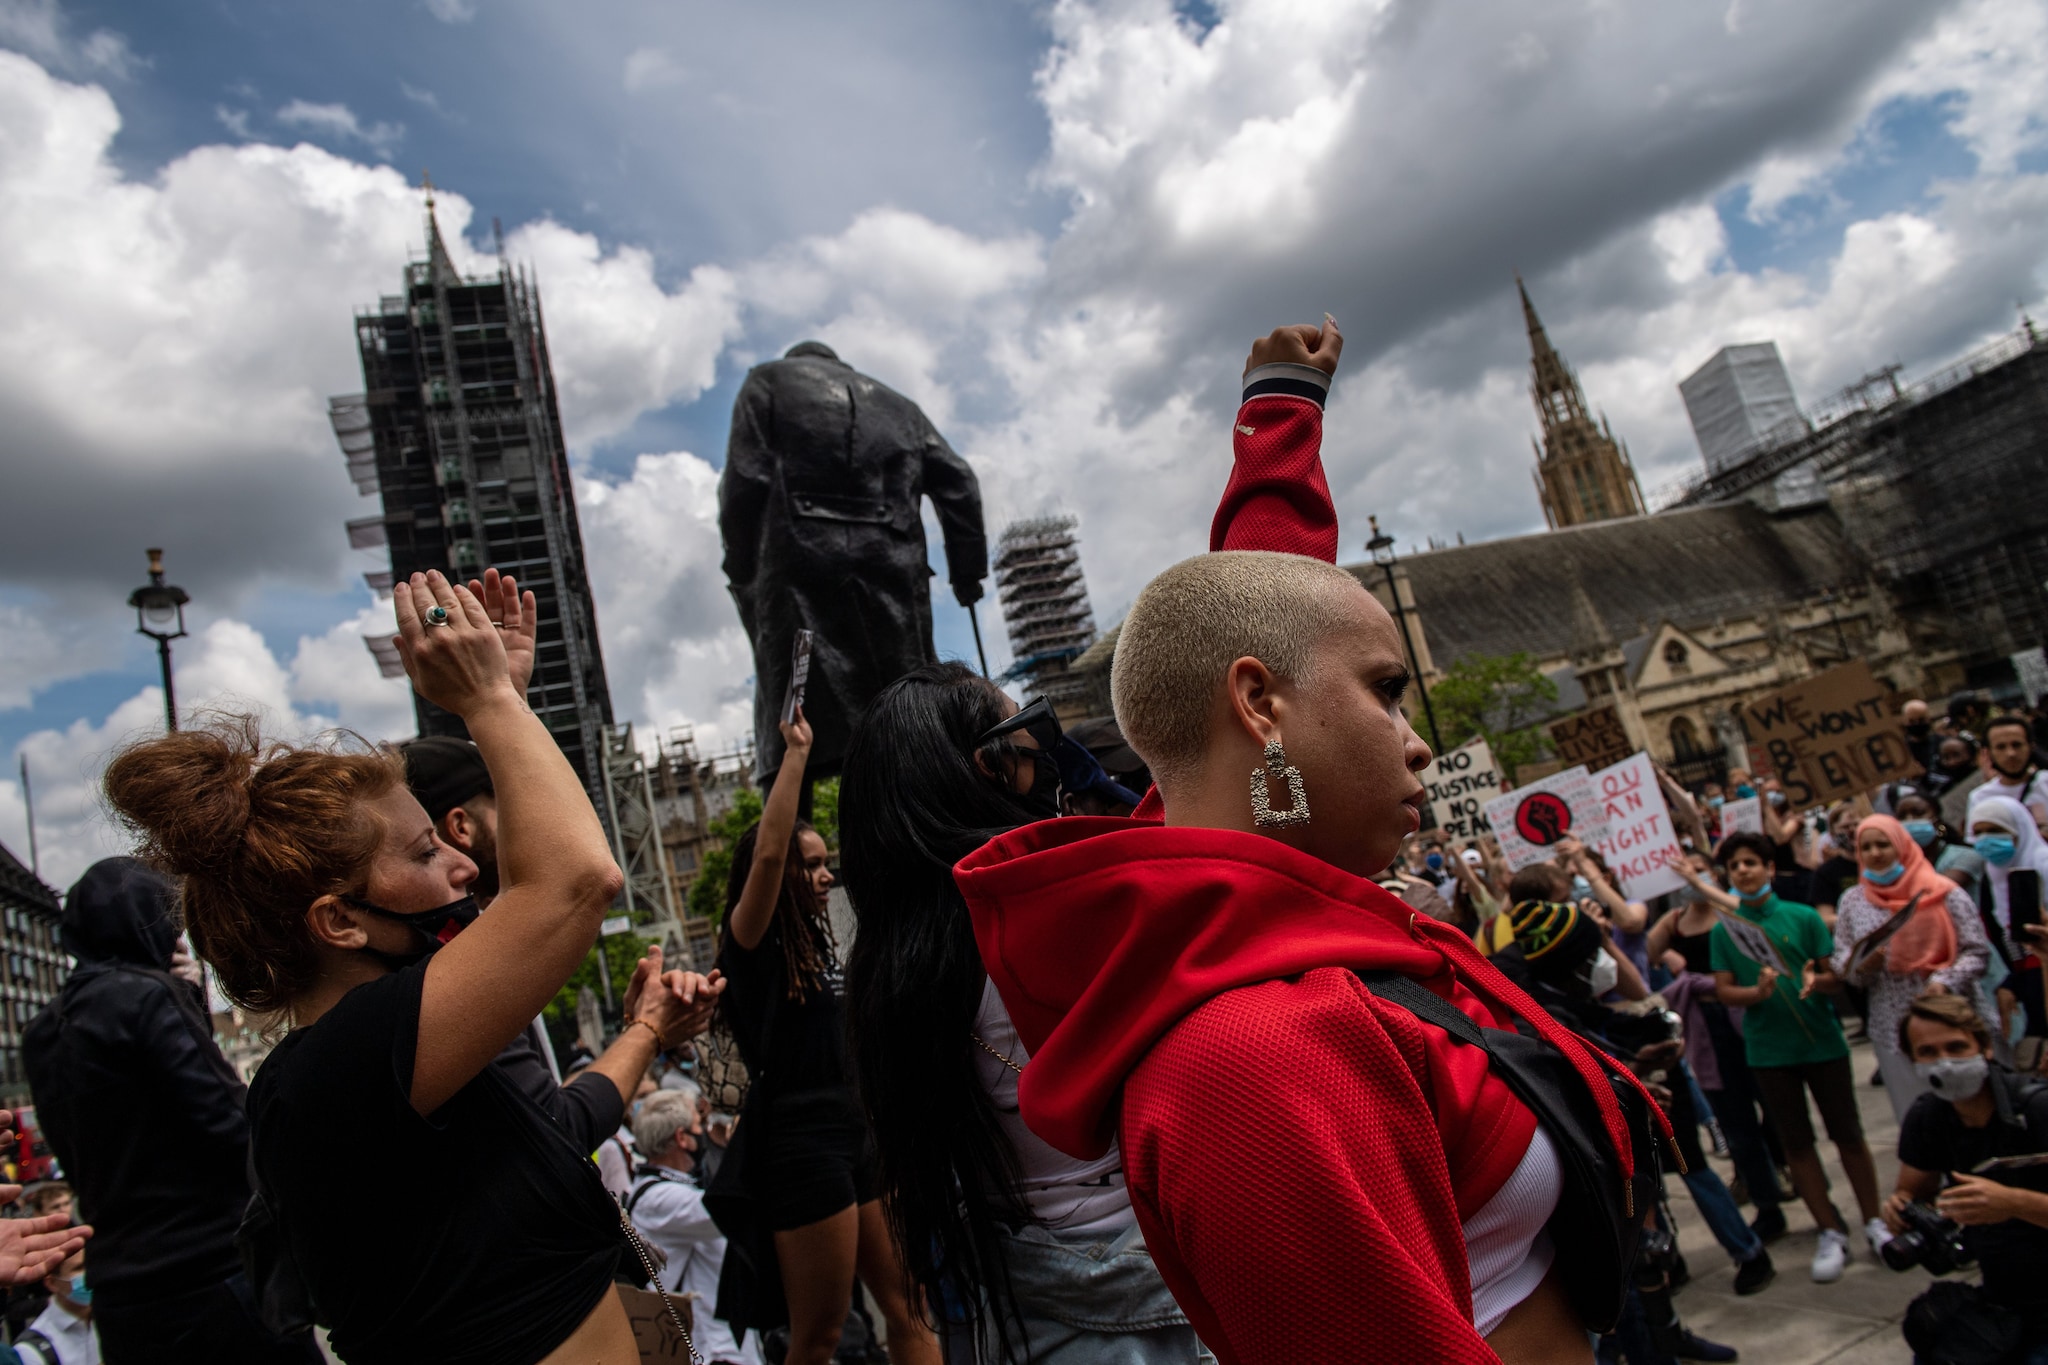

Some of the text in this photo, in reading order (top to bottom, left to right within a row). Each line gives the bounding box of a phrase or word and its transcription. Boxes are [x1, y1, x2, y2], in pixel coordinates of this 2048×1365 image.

[1752, 696, 1812, 731] WE
[1561, 725, 1630, 761] LIVES
[1768, 737, 1816, 769] BE
[1437, 752, 1471, 775] NO
[1427, 770, 1497, 802] JUSTICE
[1602, 765, 1641, 798] OU
[1449, 798, 1478, 819] NO
[1604, 792, 1643, 820] AN
